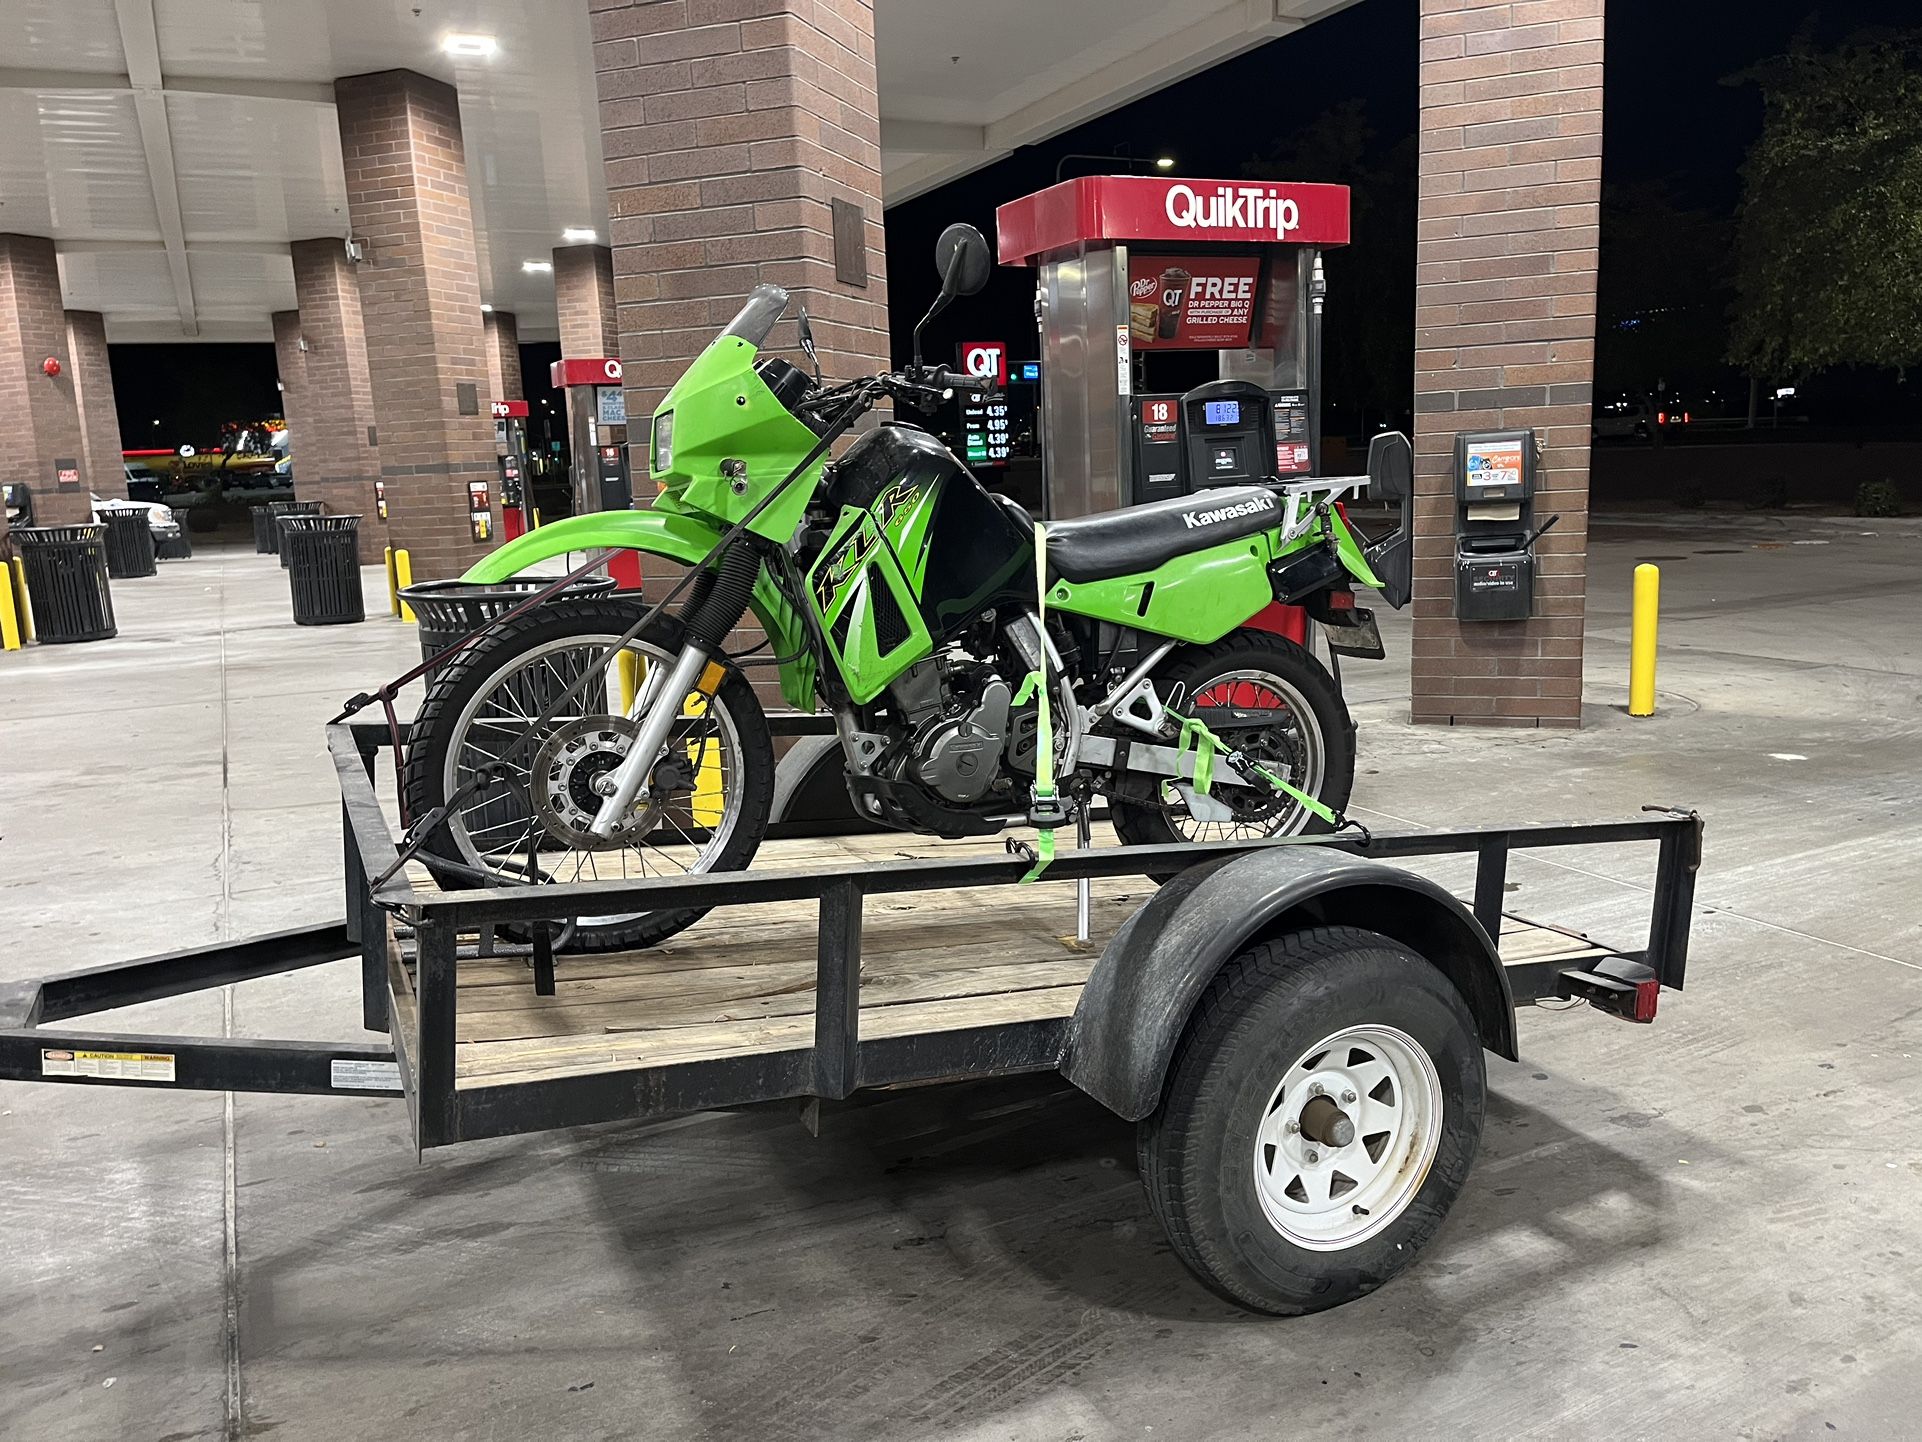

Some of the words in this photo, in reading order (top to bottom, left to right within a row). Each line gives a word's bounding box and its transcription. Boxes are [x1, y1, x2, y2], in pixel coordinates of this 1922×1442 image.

[1165, 184, 1300, 240] QuikTrip
[1130, 281, 1156, 297] Pepper
[1189, 277, 1254, 299] FREE
[1163, 289, 1182, 307] QT
[1243, 301, 1250, 309] Q
[1186, 316, 1218, 324] GRILLED
[966, 347, 1001, 378] QT
[1151, 403, 1168, 421] 18
[1182, 494, 1275, 529] Kawasaki
